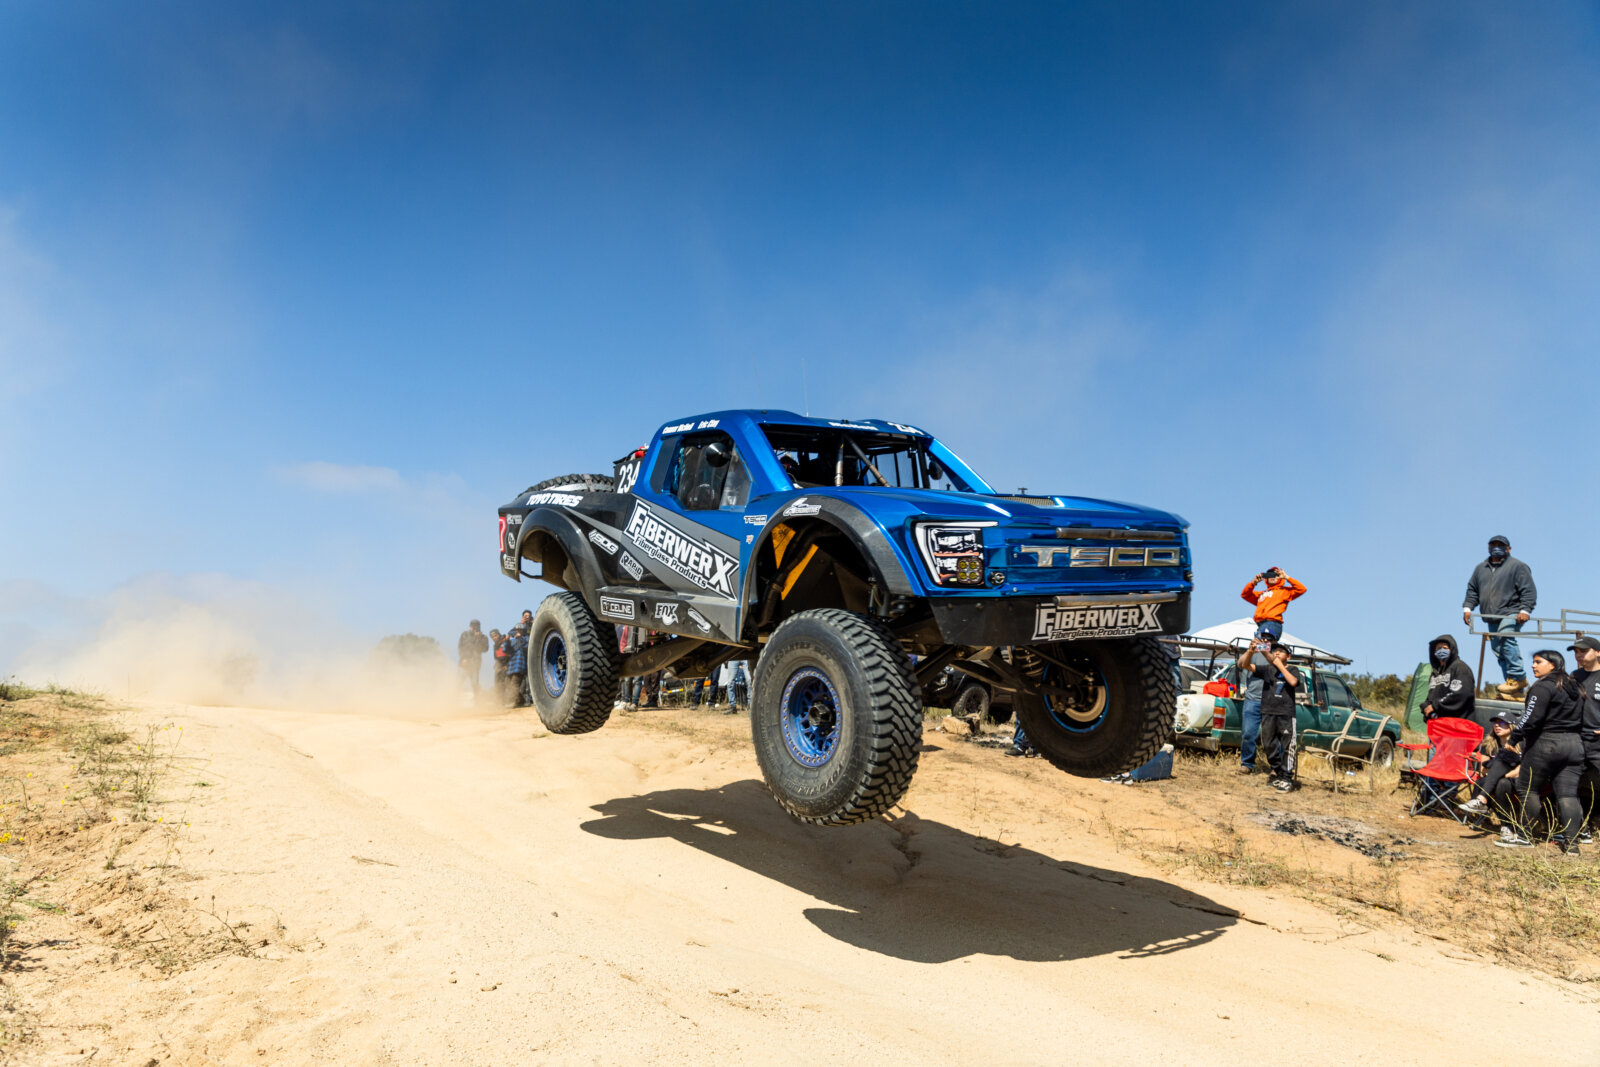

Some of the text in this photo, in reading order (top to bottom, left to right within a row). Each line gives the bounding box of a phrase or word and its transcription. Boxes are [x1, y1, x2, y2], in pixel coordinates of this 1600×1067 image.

[617, 460, 641, 494] 234
[526, 493, 584, 508] TOYO TIRES
[628, 504, 734, 596] FIBERWERX
[635, 536, 669, 565] Fiberglass
[669, 559, 707, 588] Products
[1021, 545, 1180, 568] TSCO
[656, 604, 676, 617] FOX
[1037, 603, 1158, 635] FIBERWERX
[1050, 627, 1136, 640] Fiberglass Products
